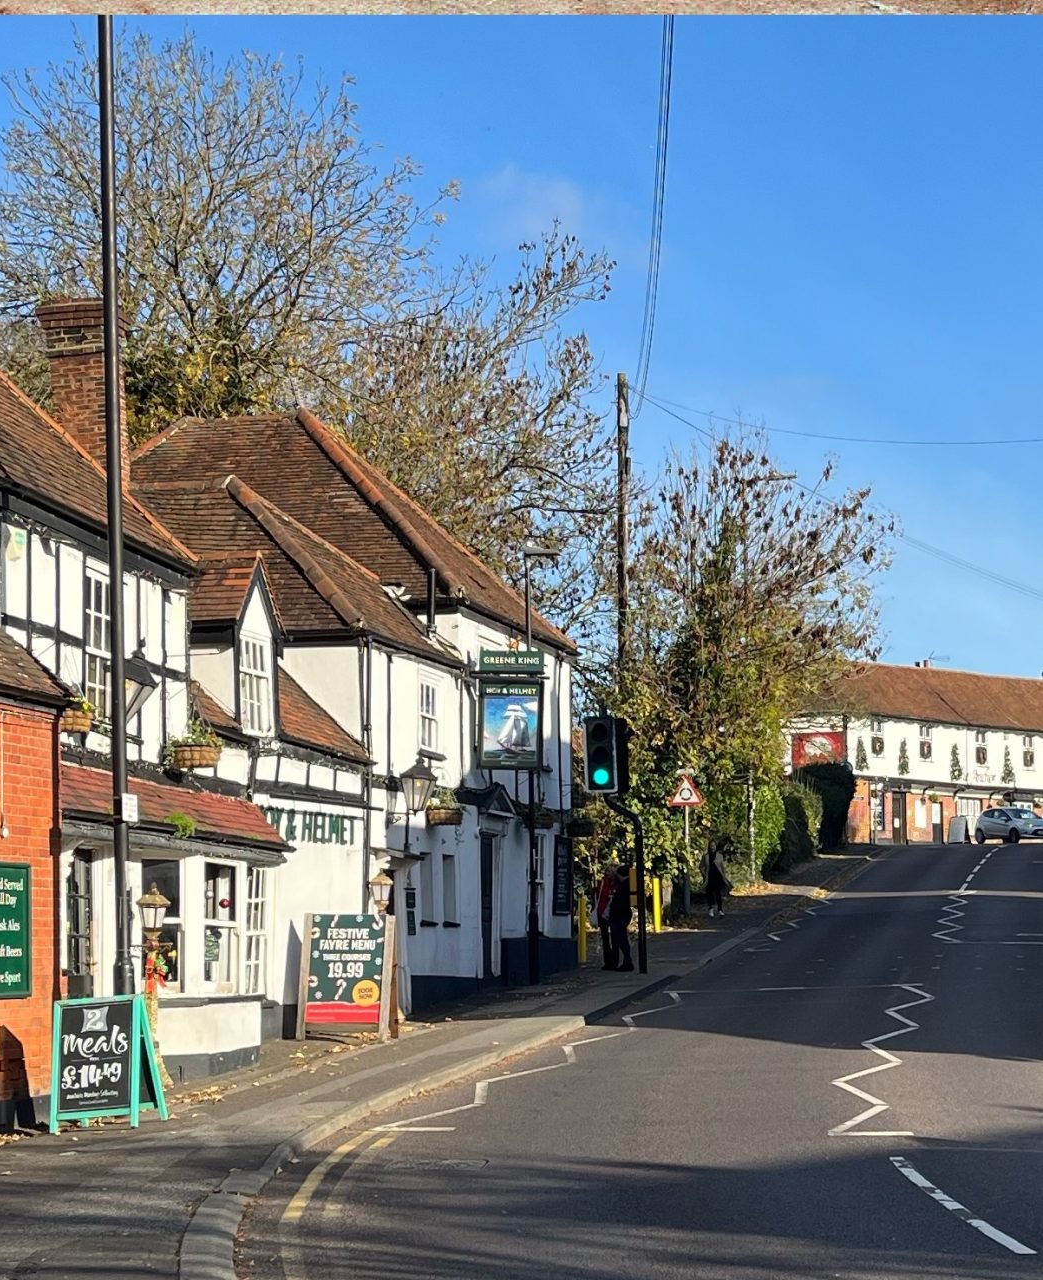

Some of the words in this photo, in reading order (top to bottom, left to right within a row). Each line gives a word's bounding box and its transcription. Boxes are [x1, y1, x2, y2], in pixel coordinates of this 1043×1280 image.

[483, 656, 516, 664] GREENE
[518, 657, 540, 665] KING
[285, 809, 297, 842] &
[301, 810, 355, 846] HELMET
[4, 879, 24, 891] Served
[5, 893, 17, 908] Day
[7, 920, 20, 931] Ales
[327, 928, 370, 939] FESTIVE
[319, 939, 349, 950] FAYRE
[351, 939, 376, 950] MENU
[5, 946, 23, 957] Beers
[323, 953, 340, 961] THREE
[341, 953, 372, 961] COURSES
[327, 962, 364, 978] 19.99
[4, 971, 21, 986] Sport
[86, 1010, 104, 1029] 2
